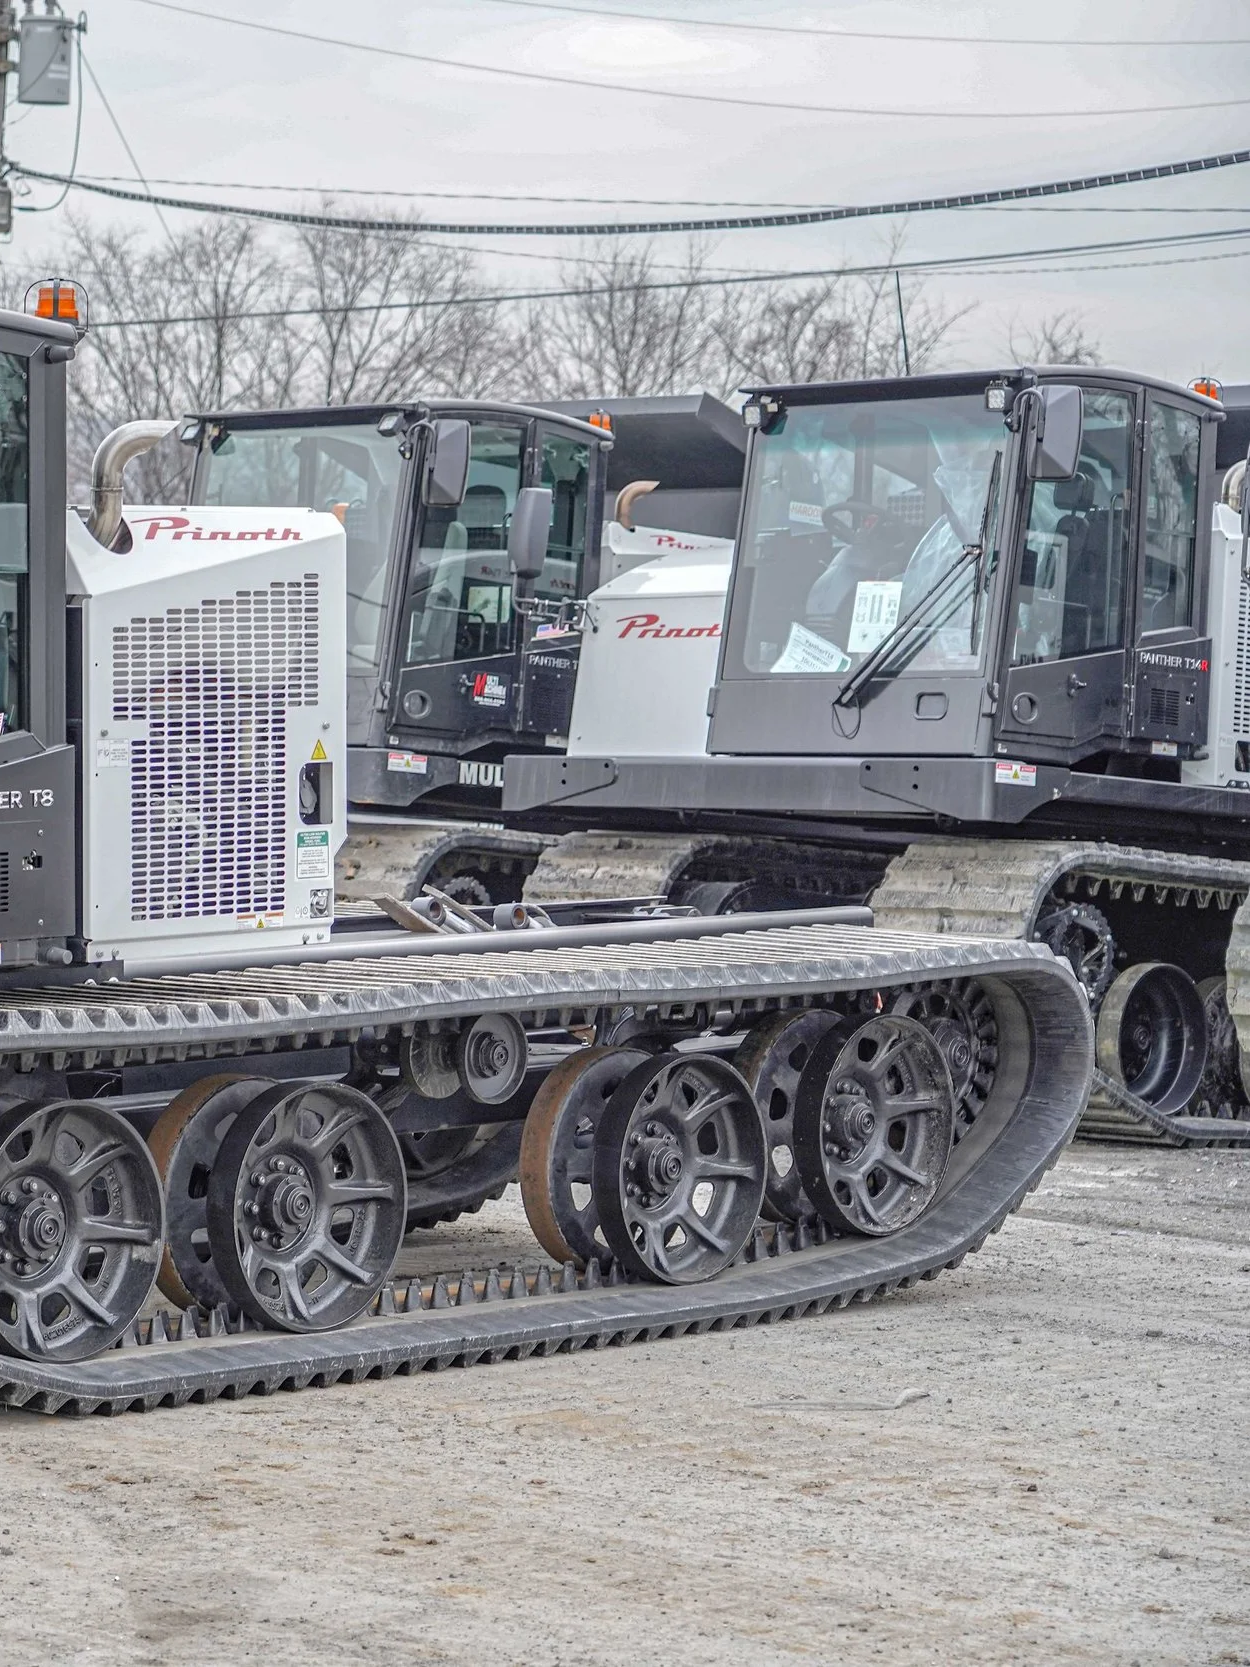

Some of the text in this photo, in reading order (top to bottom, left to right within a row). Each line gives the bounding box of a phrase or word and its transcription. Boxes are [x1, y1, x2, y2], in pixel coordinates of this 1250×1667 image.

[130, 516, 303, 541] Prinoth
[616, 613, 724, 639] Prinot
[529, 654, 570, 669] PANTHER
[1140, 652, 1209, 672] PANTHER T14R
[29, 789, 54, 807] T8
